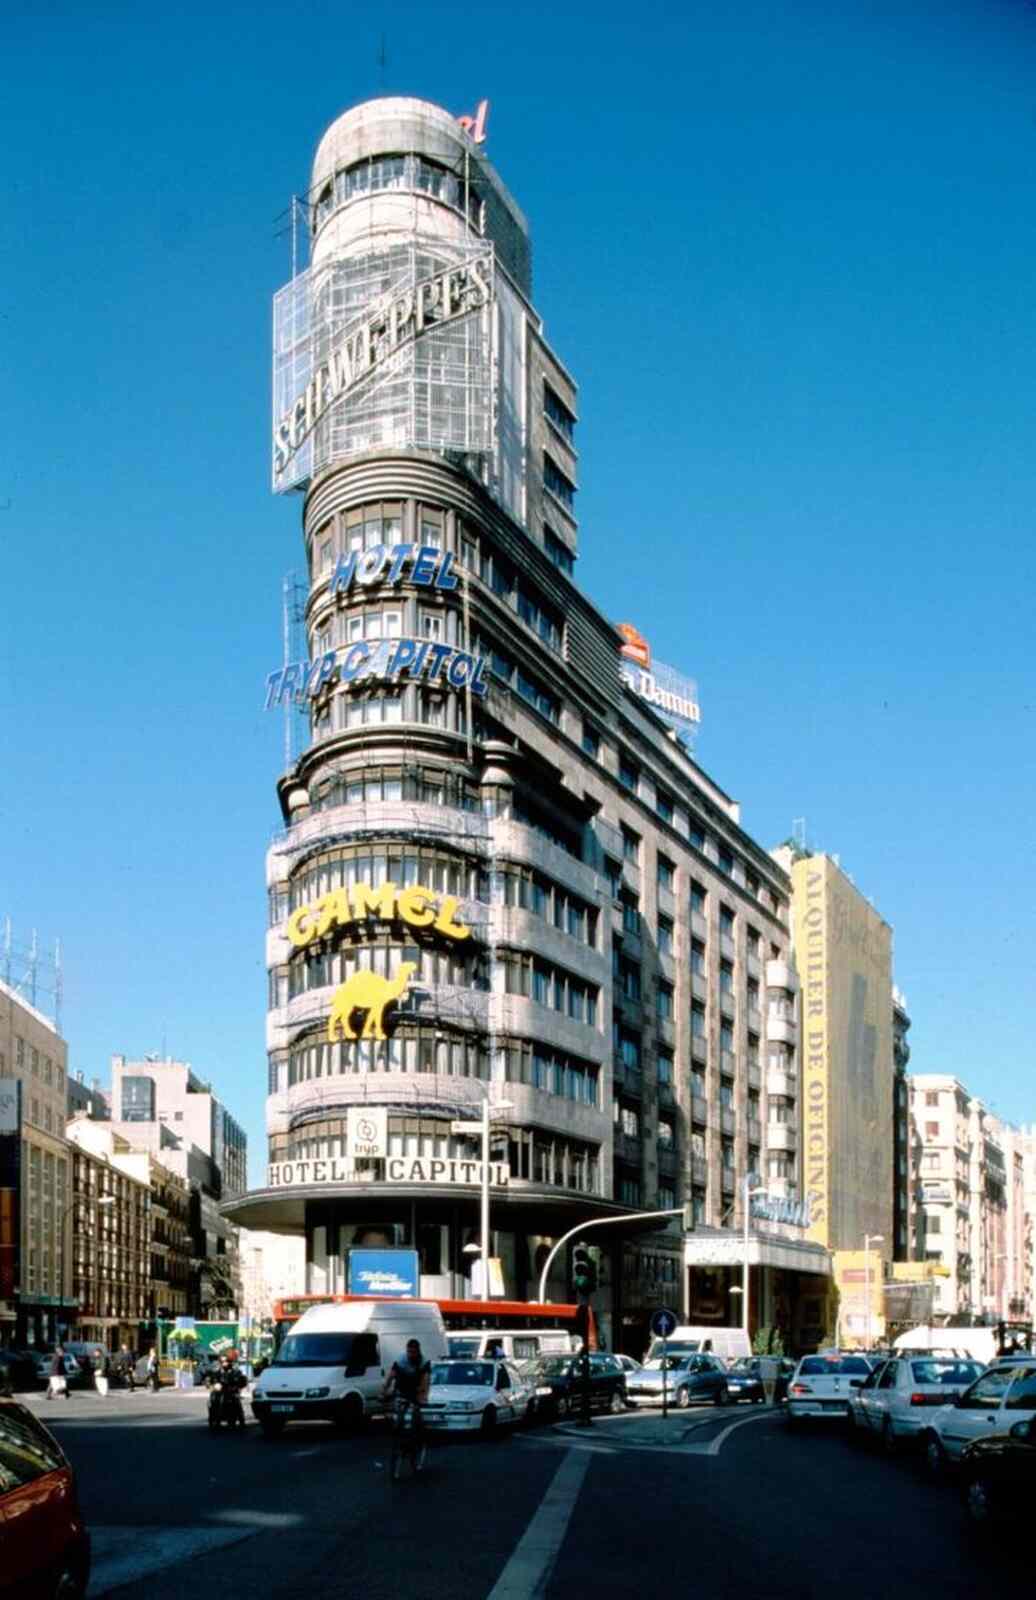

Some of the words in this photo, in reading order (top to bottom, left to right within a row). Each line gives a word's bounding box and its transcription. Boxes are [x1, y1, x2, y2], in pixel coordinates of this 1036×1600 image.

[275, 256, 491, 474] SCHWEPPES
[329, 543, 458, 592] HOTEL
[263, 650, 336, 712] TRYP
[340, 640, 488, 696] CAPITOL
[288, 881, 470, 946] CAMEL
[804, 870, 824, 1018] ALQUILER
[808, 1032, 825, 1070] DE
[270, 1160, 345, 1186] HOTEL
[808, 1080, 825, 1222] OFICINAS
